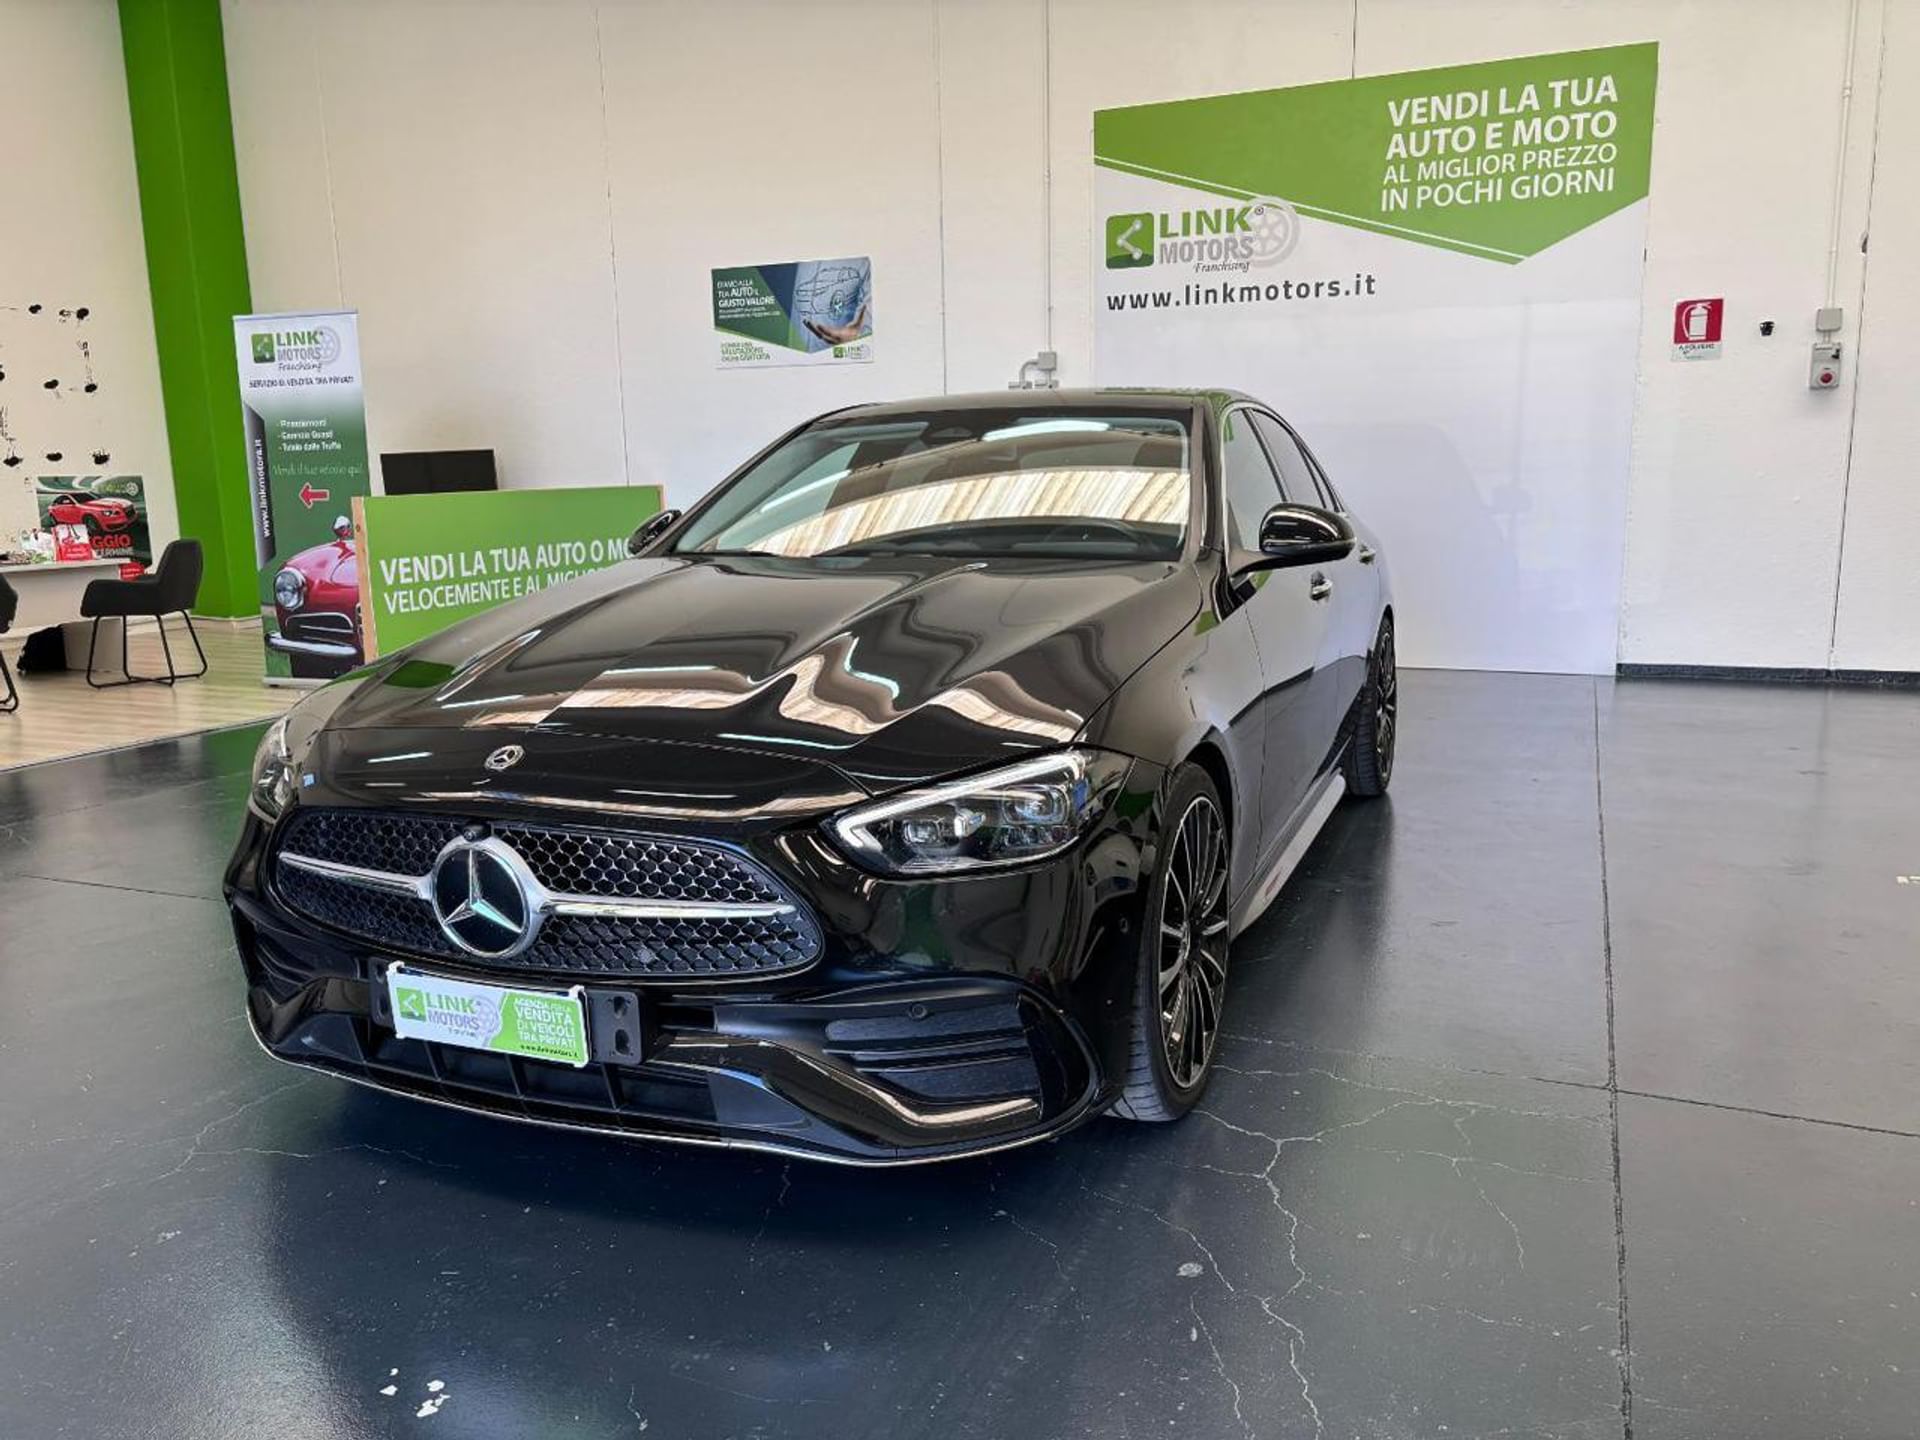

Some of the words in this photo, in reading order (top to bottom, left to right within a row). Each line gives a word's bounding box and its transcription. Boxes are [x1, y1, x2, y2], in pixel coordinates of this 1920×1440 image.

[1388, 89, 1489, 128] VENDI
[1499, 84, 1541, 115] LA
[1548, 74, 1619, 108] TUA
[1386, 126, 1476, 160] AUTO
[1485, 122, 1504, 149] E
[1512, 110, 1617, 147] MOTO
[1383, 165, 1411, 185] AL
[1417, 152, 1516, 181] MIGLIOR
[1522, 142, 1617, 171] PREZZO
[1381, 186, 1408, 212] IN
[1416, 178, 1503, 209] POCHI
[1511, 167, 1615, 200] GIORNI
[1160, 206, 1253, 238] LINK
[1160, 236, 1254, 264] MOTORS
[1194, 261, 1250, 274] Franchising
[719, 298, 745, 308] GIUSTO
[746, 295, 775, 306] VALORE
[731, 286, 753, 297] AUTO
[1107, 273, 1376, 311] www.linkmotors.it
[276, 330, 320, 347] LINK
[277, 347, 321, 361] MOTORS
[380, 553, 455, 585] VENDI
[461, 550, 486, 577] LA
[489, 547, 530, 574] TUA
[536, 541, 586, 569] AUTO
[590, 540, 604, 563] O
[384, 578, 510, 615] VELOCEMENTE
[513, 577, 523, 597] E
[426, 991, 476, 1014] LINK
[427, 1008, 480, 1031] MOTORS
[516, 1006, 573, 1026] VENDITA
[517, 1019, 528, 1031] DI
[530, 1020, 576, 1038] VEICOLI
[519, 1030, 537, 1043] TRA
[539, 1033, 577, 1049] PRIVATI
